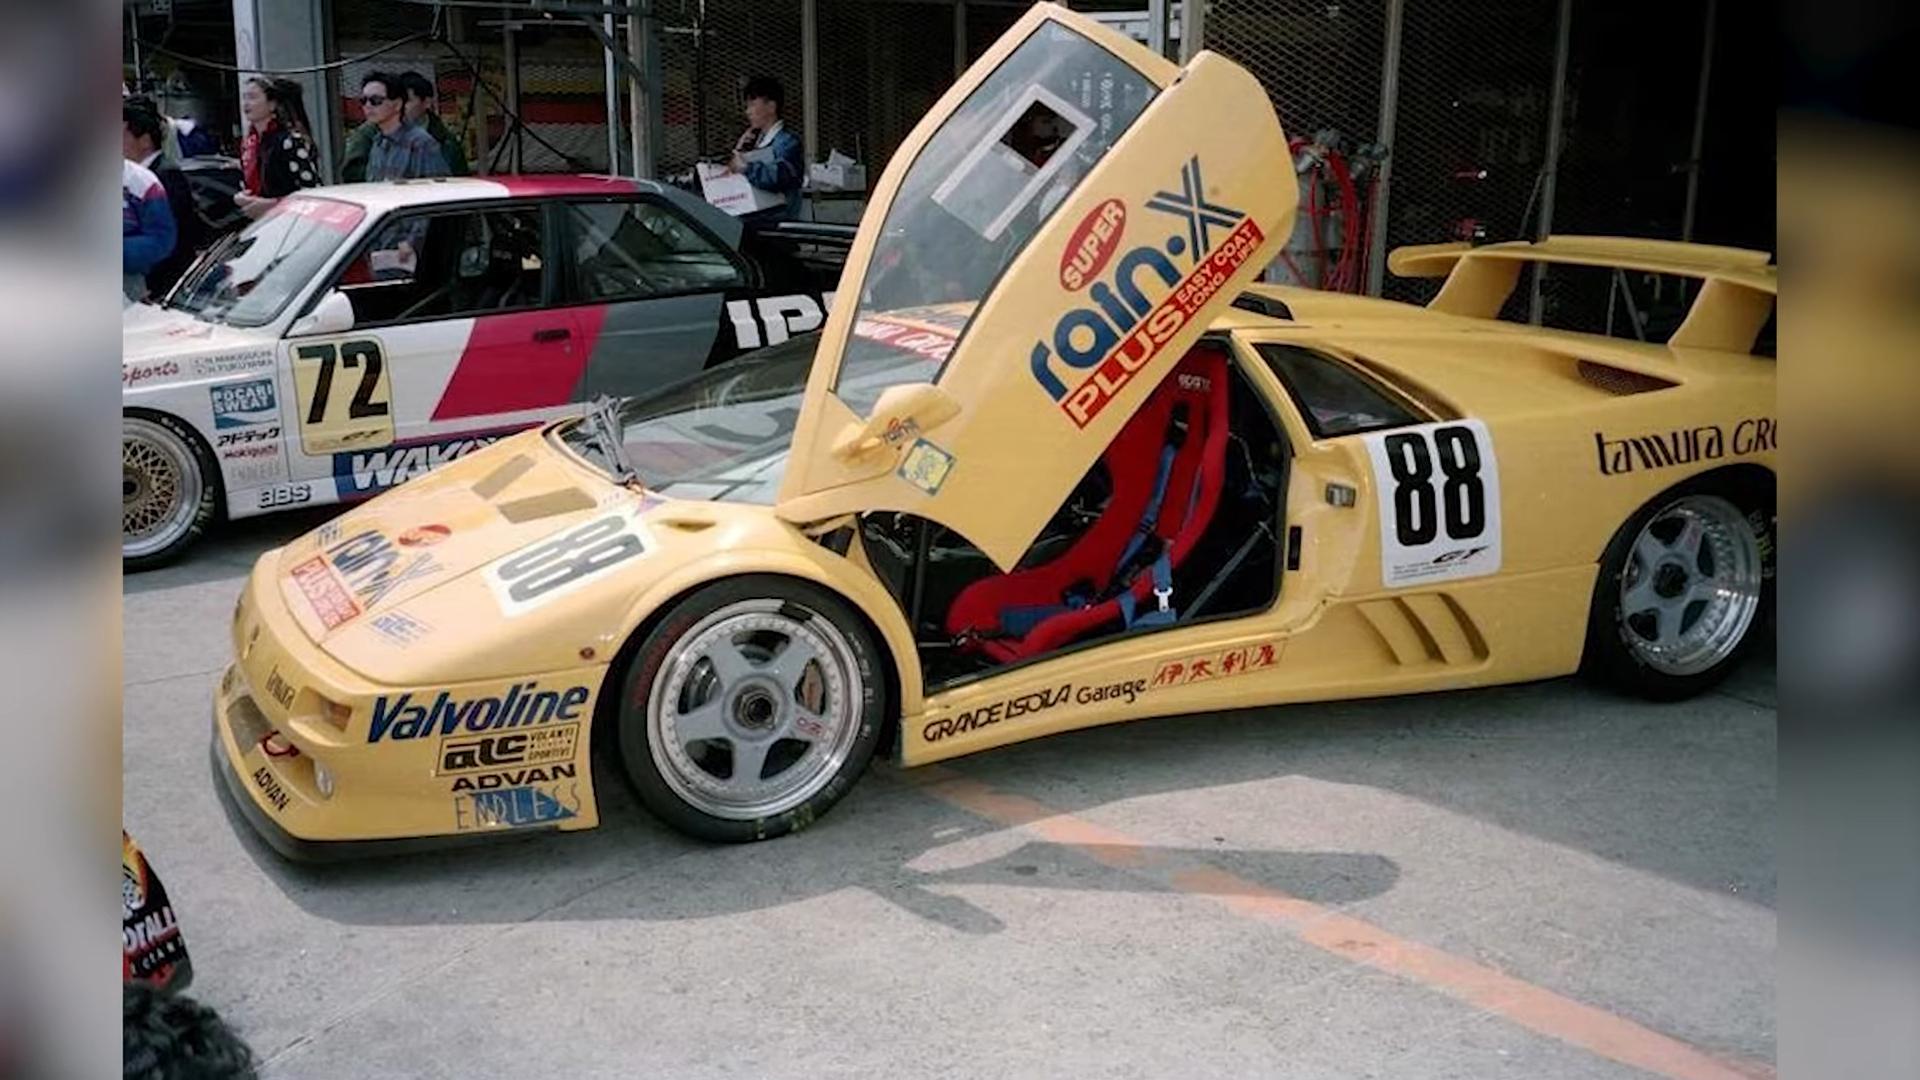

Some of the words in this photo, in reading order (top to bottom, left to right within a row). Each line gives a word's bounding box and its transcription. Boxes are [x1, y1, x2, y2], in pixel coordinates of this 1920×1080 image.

[1062, 202, 1124, 288] SUPER
[1176, 263, 1213, 303] EASY
[1213, 225, 1252, 267] COAT
[726, 291, 838, 349] IP
[1184, 272, 1226, 314] LONG
[212, 383, 273, 402] POCARI
[297, 340, 389, 425] 72
[1067, 304, 1185, 423] PLUS
[213, 398, 269, 414] SWEAT
[257, 485, 311, 509] BBS
[1384, 426, 1489, 547] 88
[497, 515, 645, 602] 88
[368, 681, 589, 743] Valvoline
[923, 702, 1004, 742] GRANDE
[1005, 684, 1072, 720] ISOLA
[1076, 678, 1148, 705] Garage
[254, 766, 290, 812] ADVAN
[451, 763, 577, 792] ADVAN
[455, 782, 581, 830] ENDLESS
